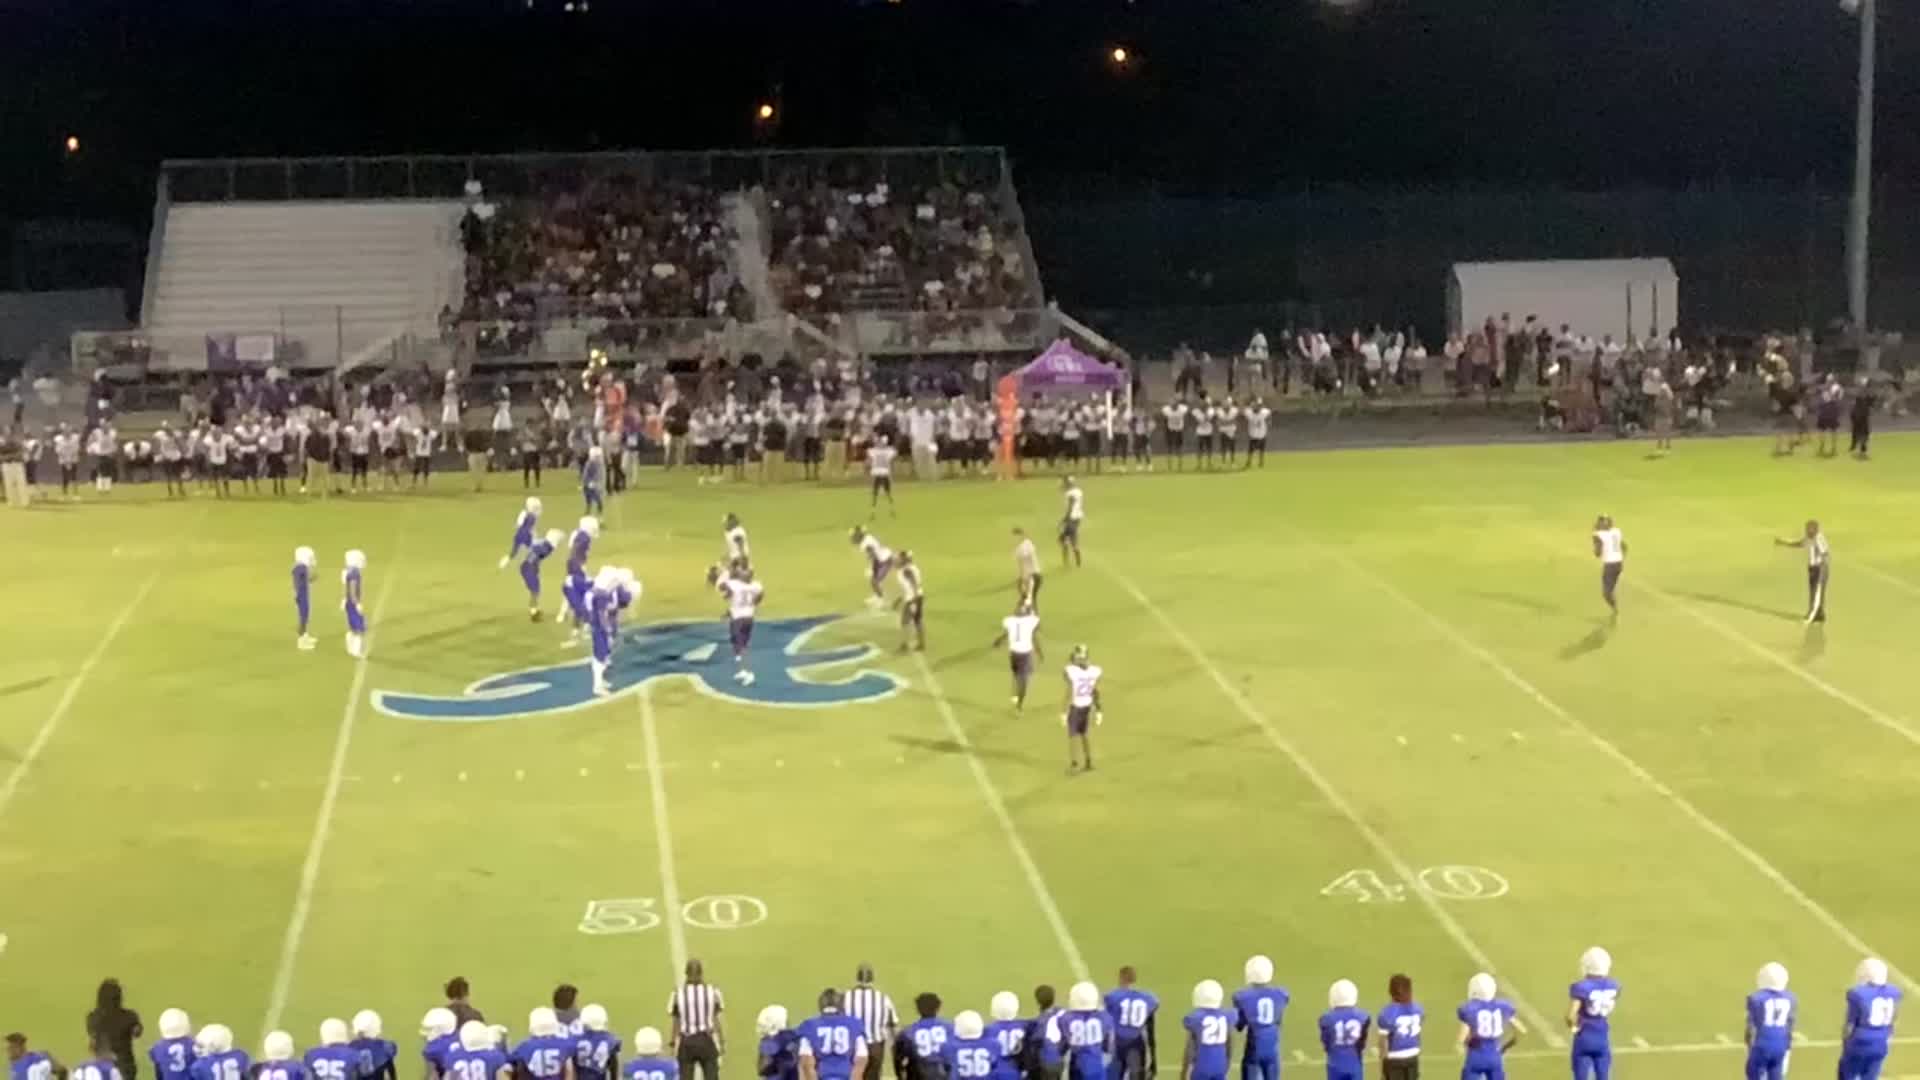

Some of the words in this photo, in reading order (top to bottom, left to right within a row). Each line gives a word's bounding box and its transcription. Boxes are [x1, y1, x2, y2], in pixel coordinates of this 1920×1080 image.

[1119, 998, 1147, 1026] 10
[1257, 997, 1274, 1025] 0
[1476, 1008, 1503, 1037] 81
[1763, 997, 1791, 1026] 17
[816, 1026, 850, 1055] 79
[1201, 1015, 1227, 1044] 21
[168, 1043, 186, 1072] 3
[528, 1049, 561, 1077] 45
[576, 1040, 609, 1068] 24
[957, 1048, 990, 1077] 56
